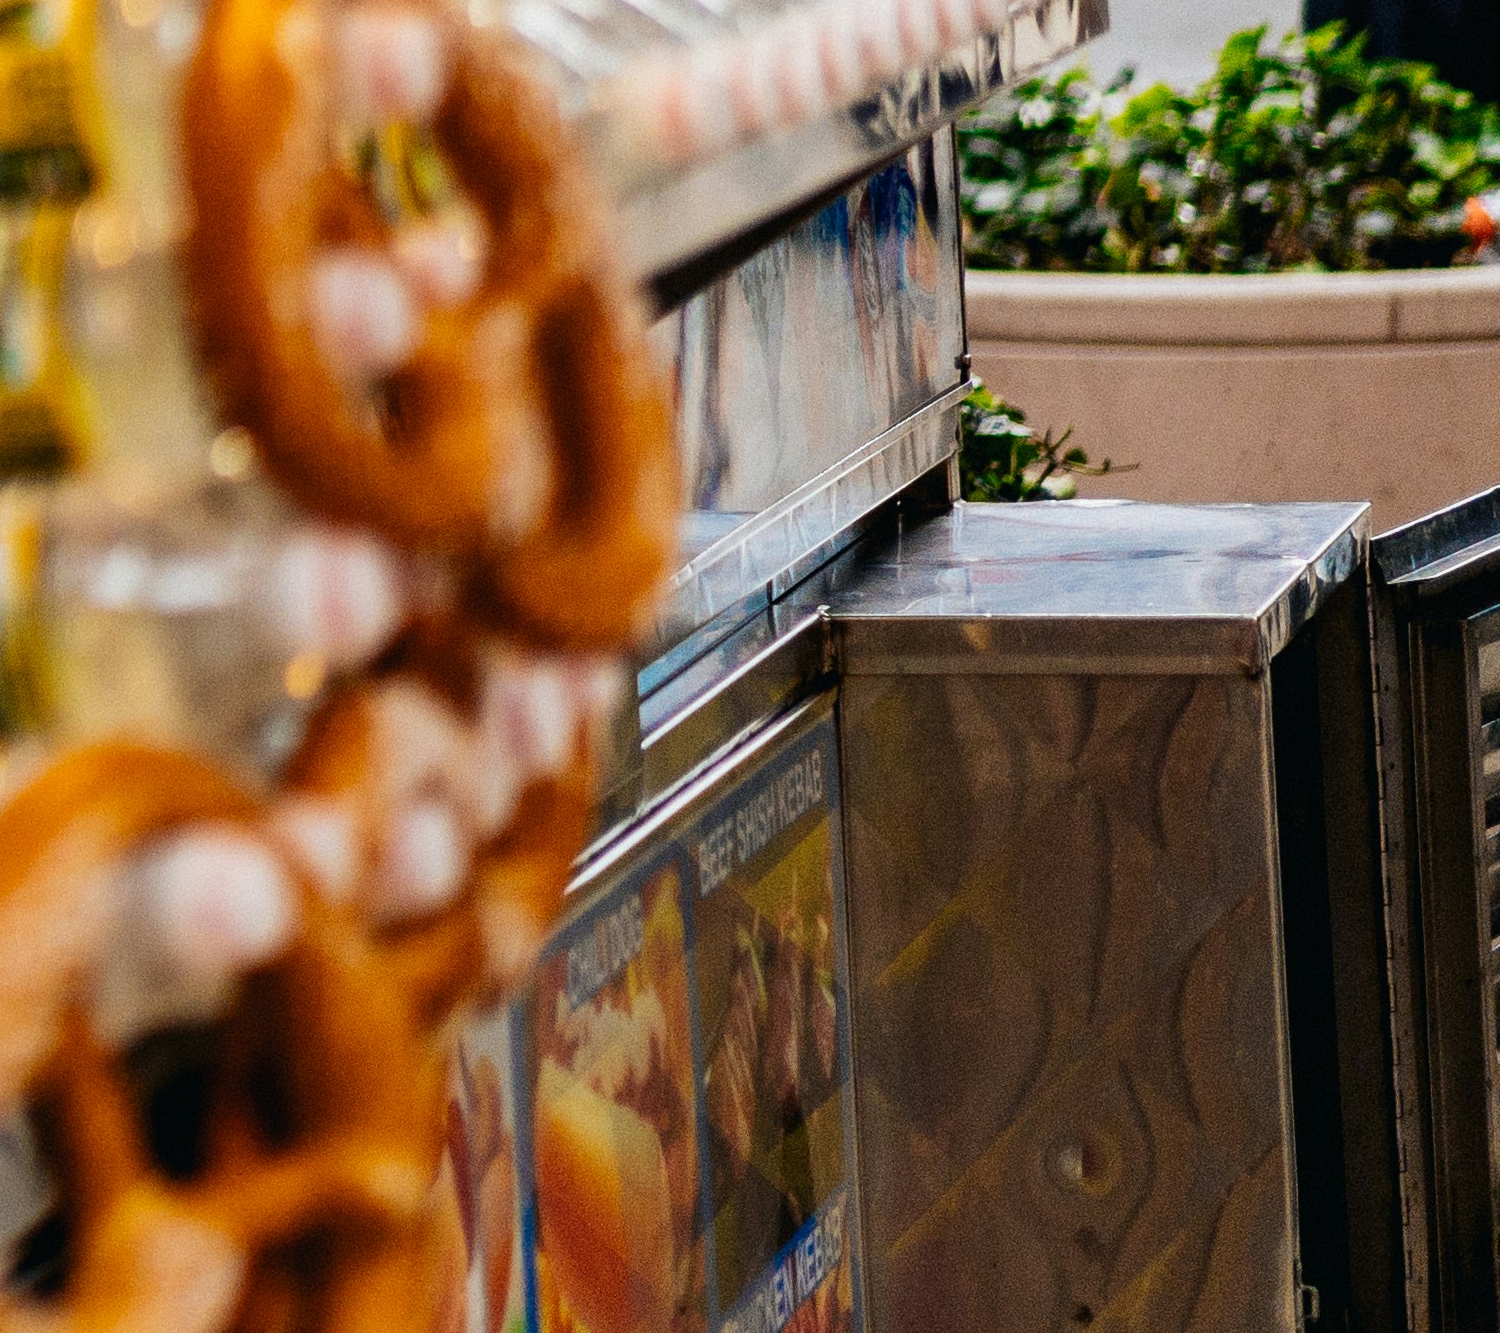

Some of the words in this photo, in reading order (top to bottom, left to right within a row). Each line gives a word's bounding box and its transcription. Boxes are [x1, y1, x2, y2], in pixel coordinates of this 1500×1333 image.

[699, 815, 734, 898] BEEF
[737, 781, 775, 865] SHISH
[776, 747, 823, 832] KEBAB
